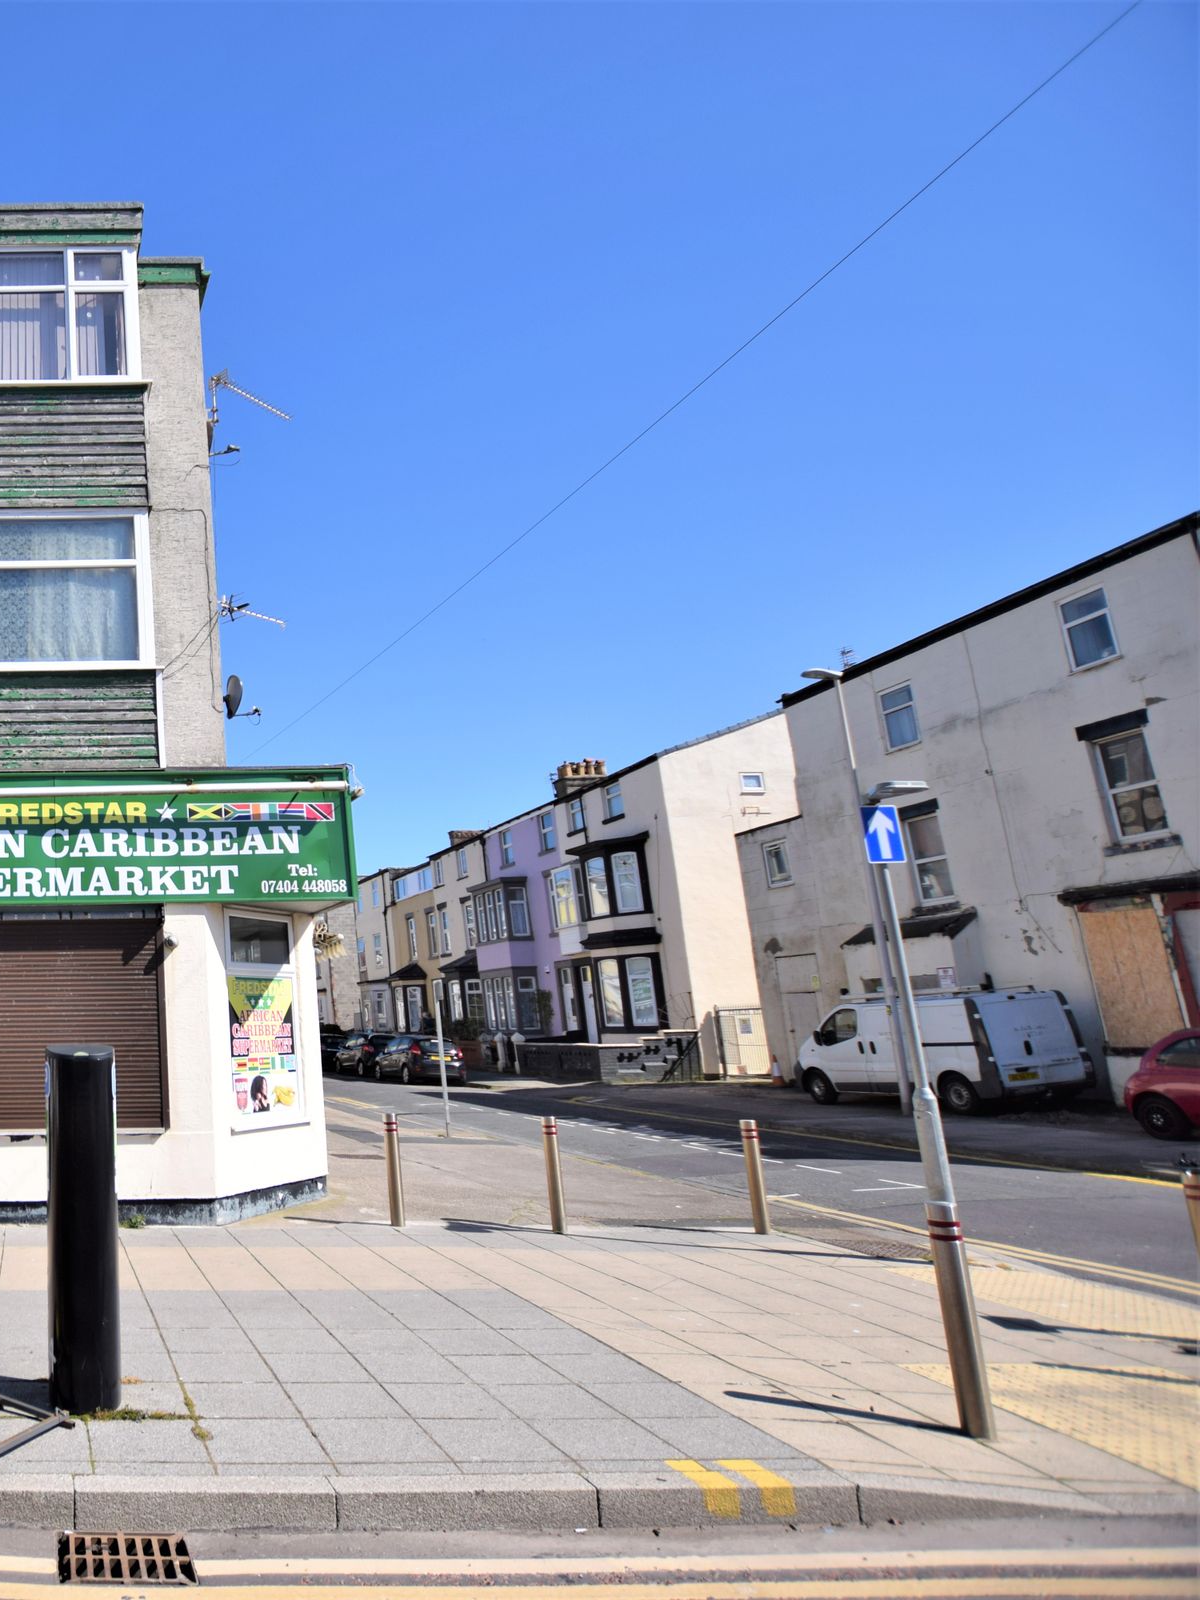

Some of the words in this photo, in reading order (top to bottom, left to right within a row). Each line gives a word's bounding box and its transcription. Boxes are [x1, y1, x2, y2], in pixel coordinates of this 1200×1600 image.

[41, 826, 301, 859] CARIBBEAN
[288, 864, 318, 877] Tel:
[261, 880, 299, 894] 07404
[302, 879, 347, 893] 448058
[239, 1008, 283, 1023] AFRICAN
[231, 1023, 292, 1038] CARIBBEAN
